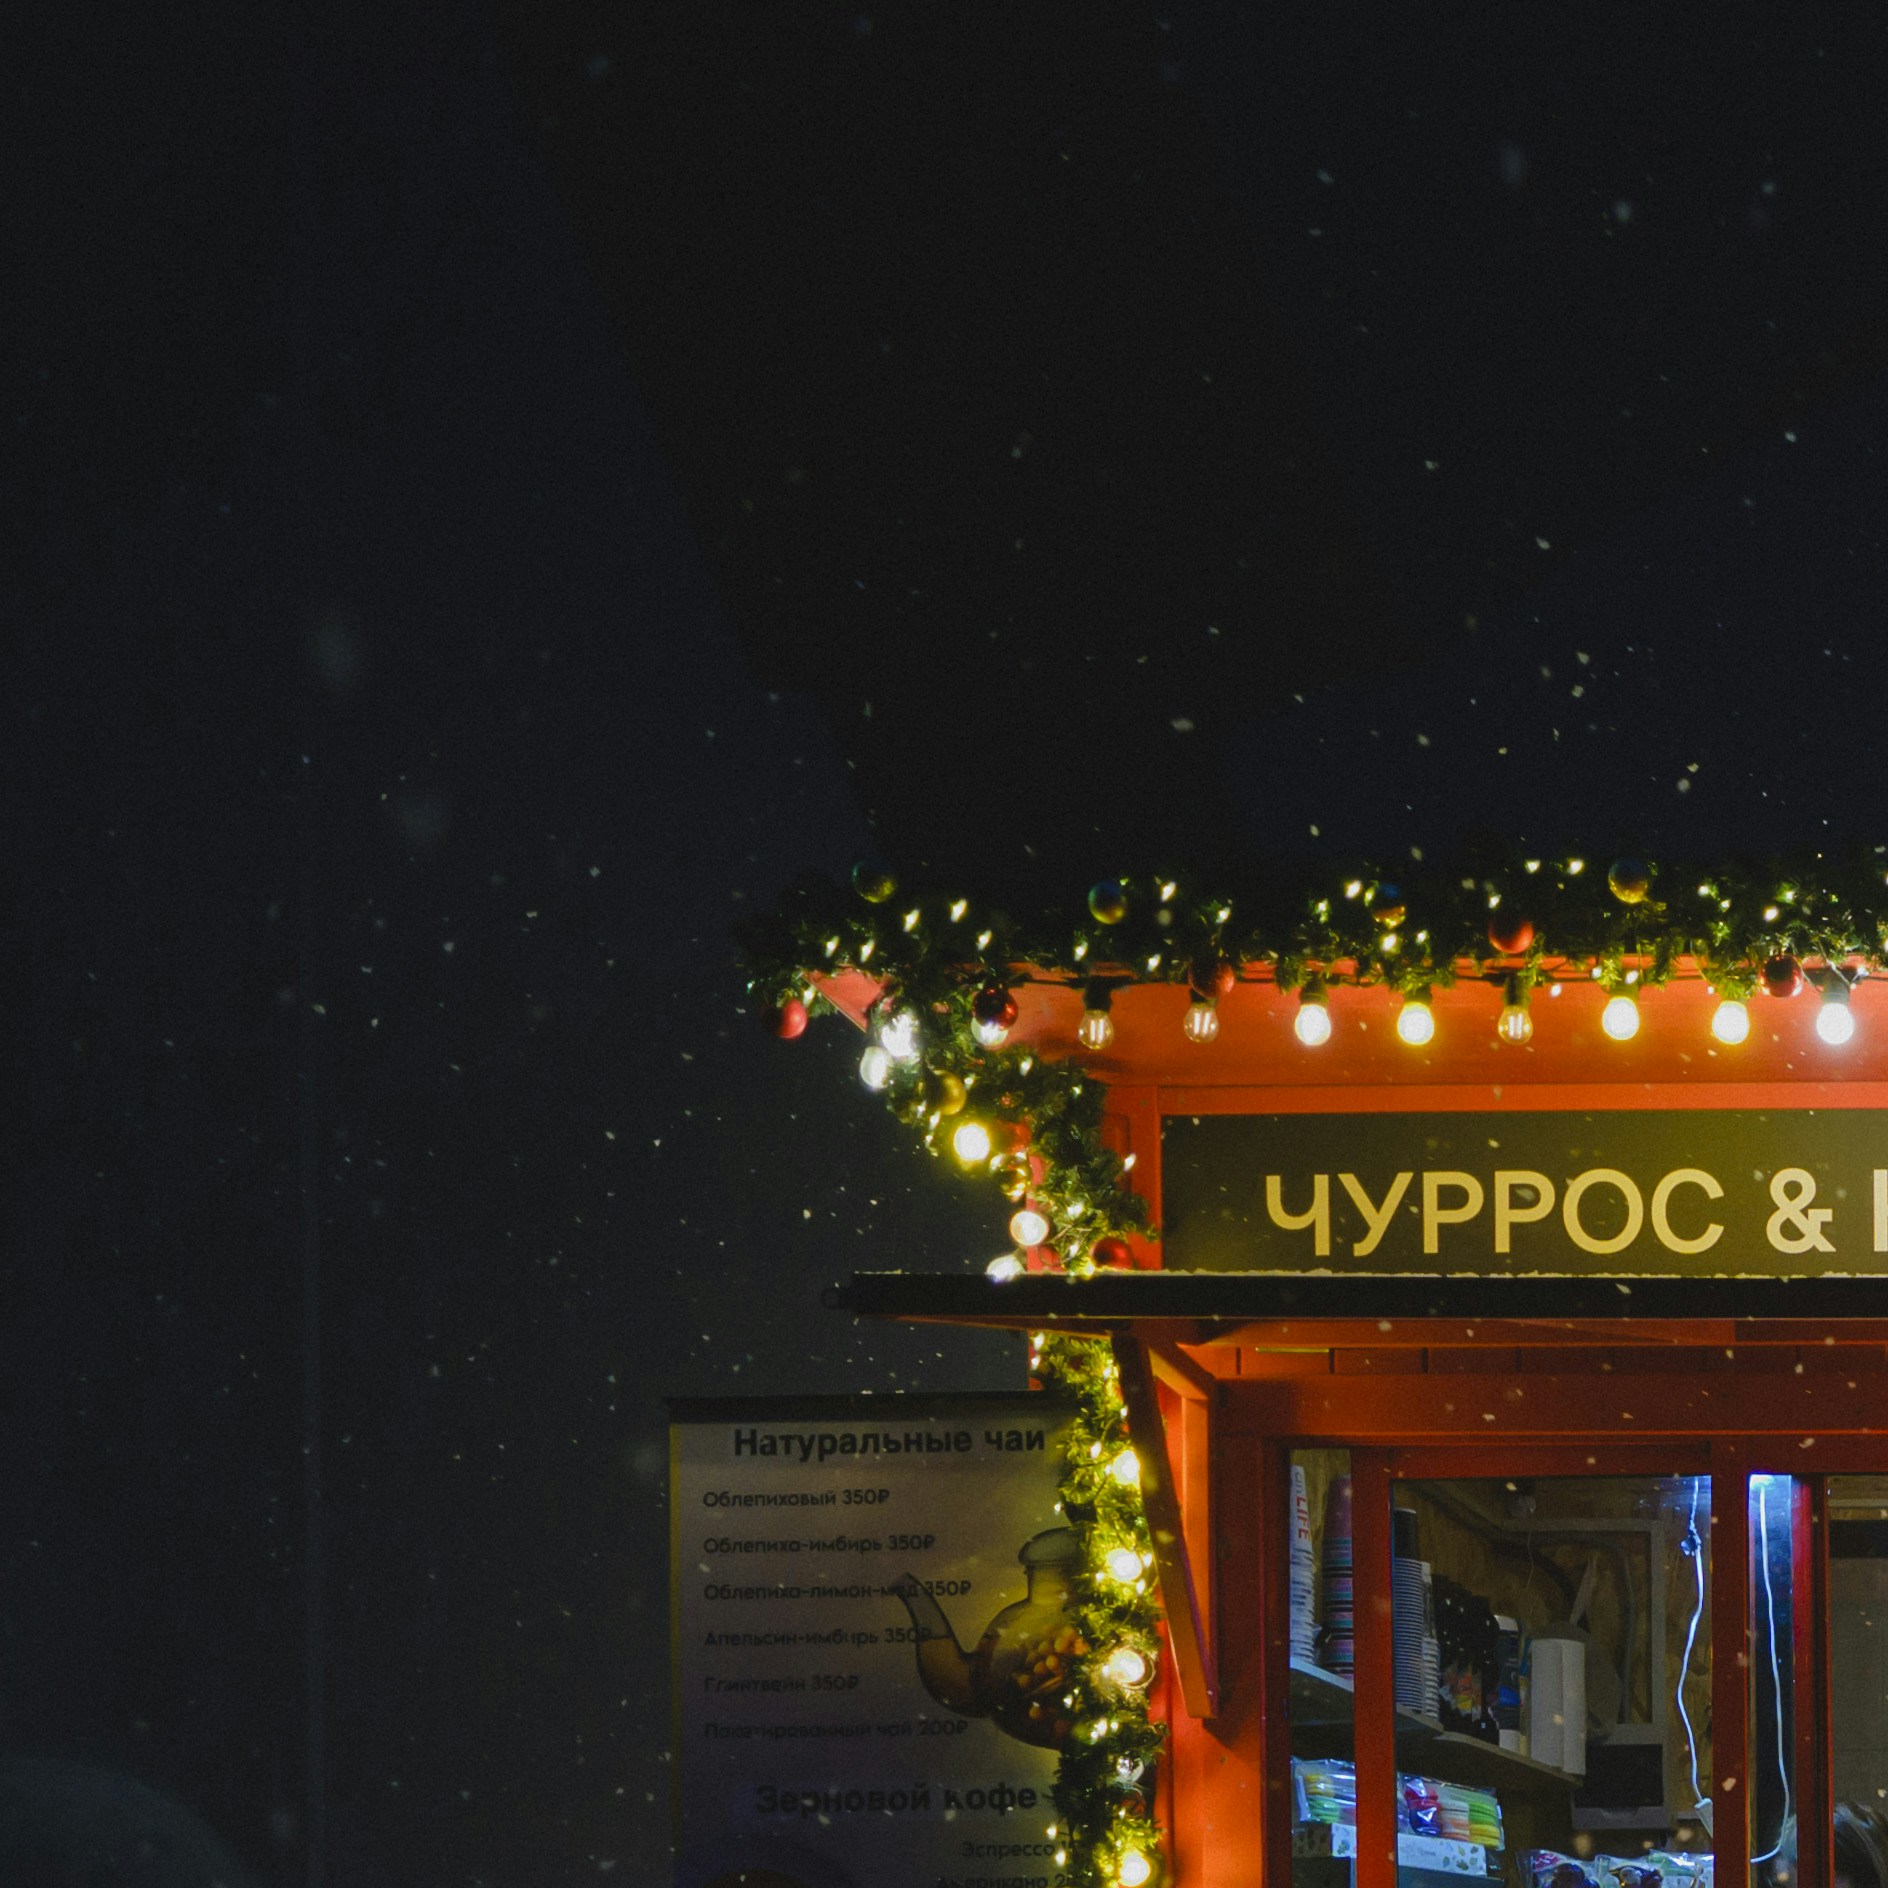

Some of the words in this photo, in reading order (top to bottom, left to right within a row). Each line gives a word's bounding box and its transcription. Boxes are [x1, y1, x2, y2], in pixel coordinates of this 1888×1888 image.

[1265, 1167, 1725, 1257] ЧУРРОС
[1766, 1166, 1837, 1254] &
[734, 1428, 973, 1462] Натуральные
[985, 1429, 1046, 1452] чаи
[703, 1489, 837, 1508] Облепиховый
[703, 1534, 882, 1556] Облепиха-имбирь
[756, 1781, 930, 1819] Зерновой
[944, 1781, 1038, 1816] кофе
